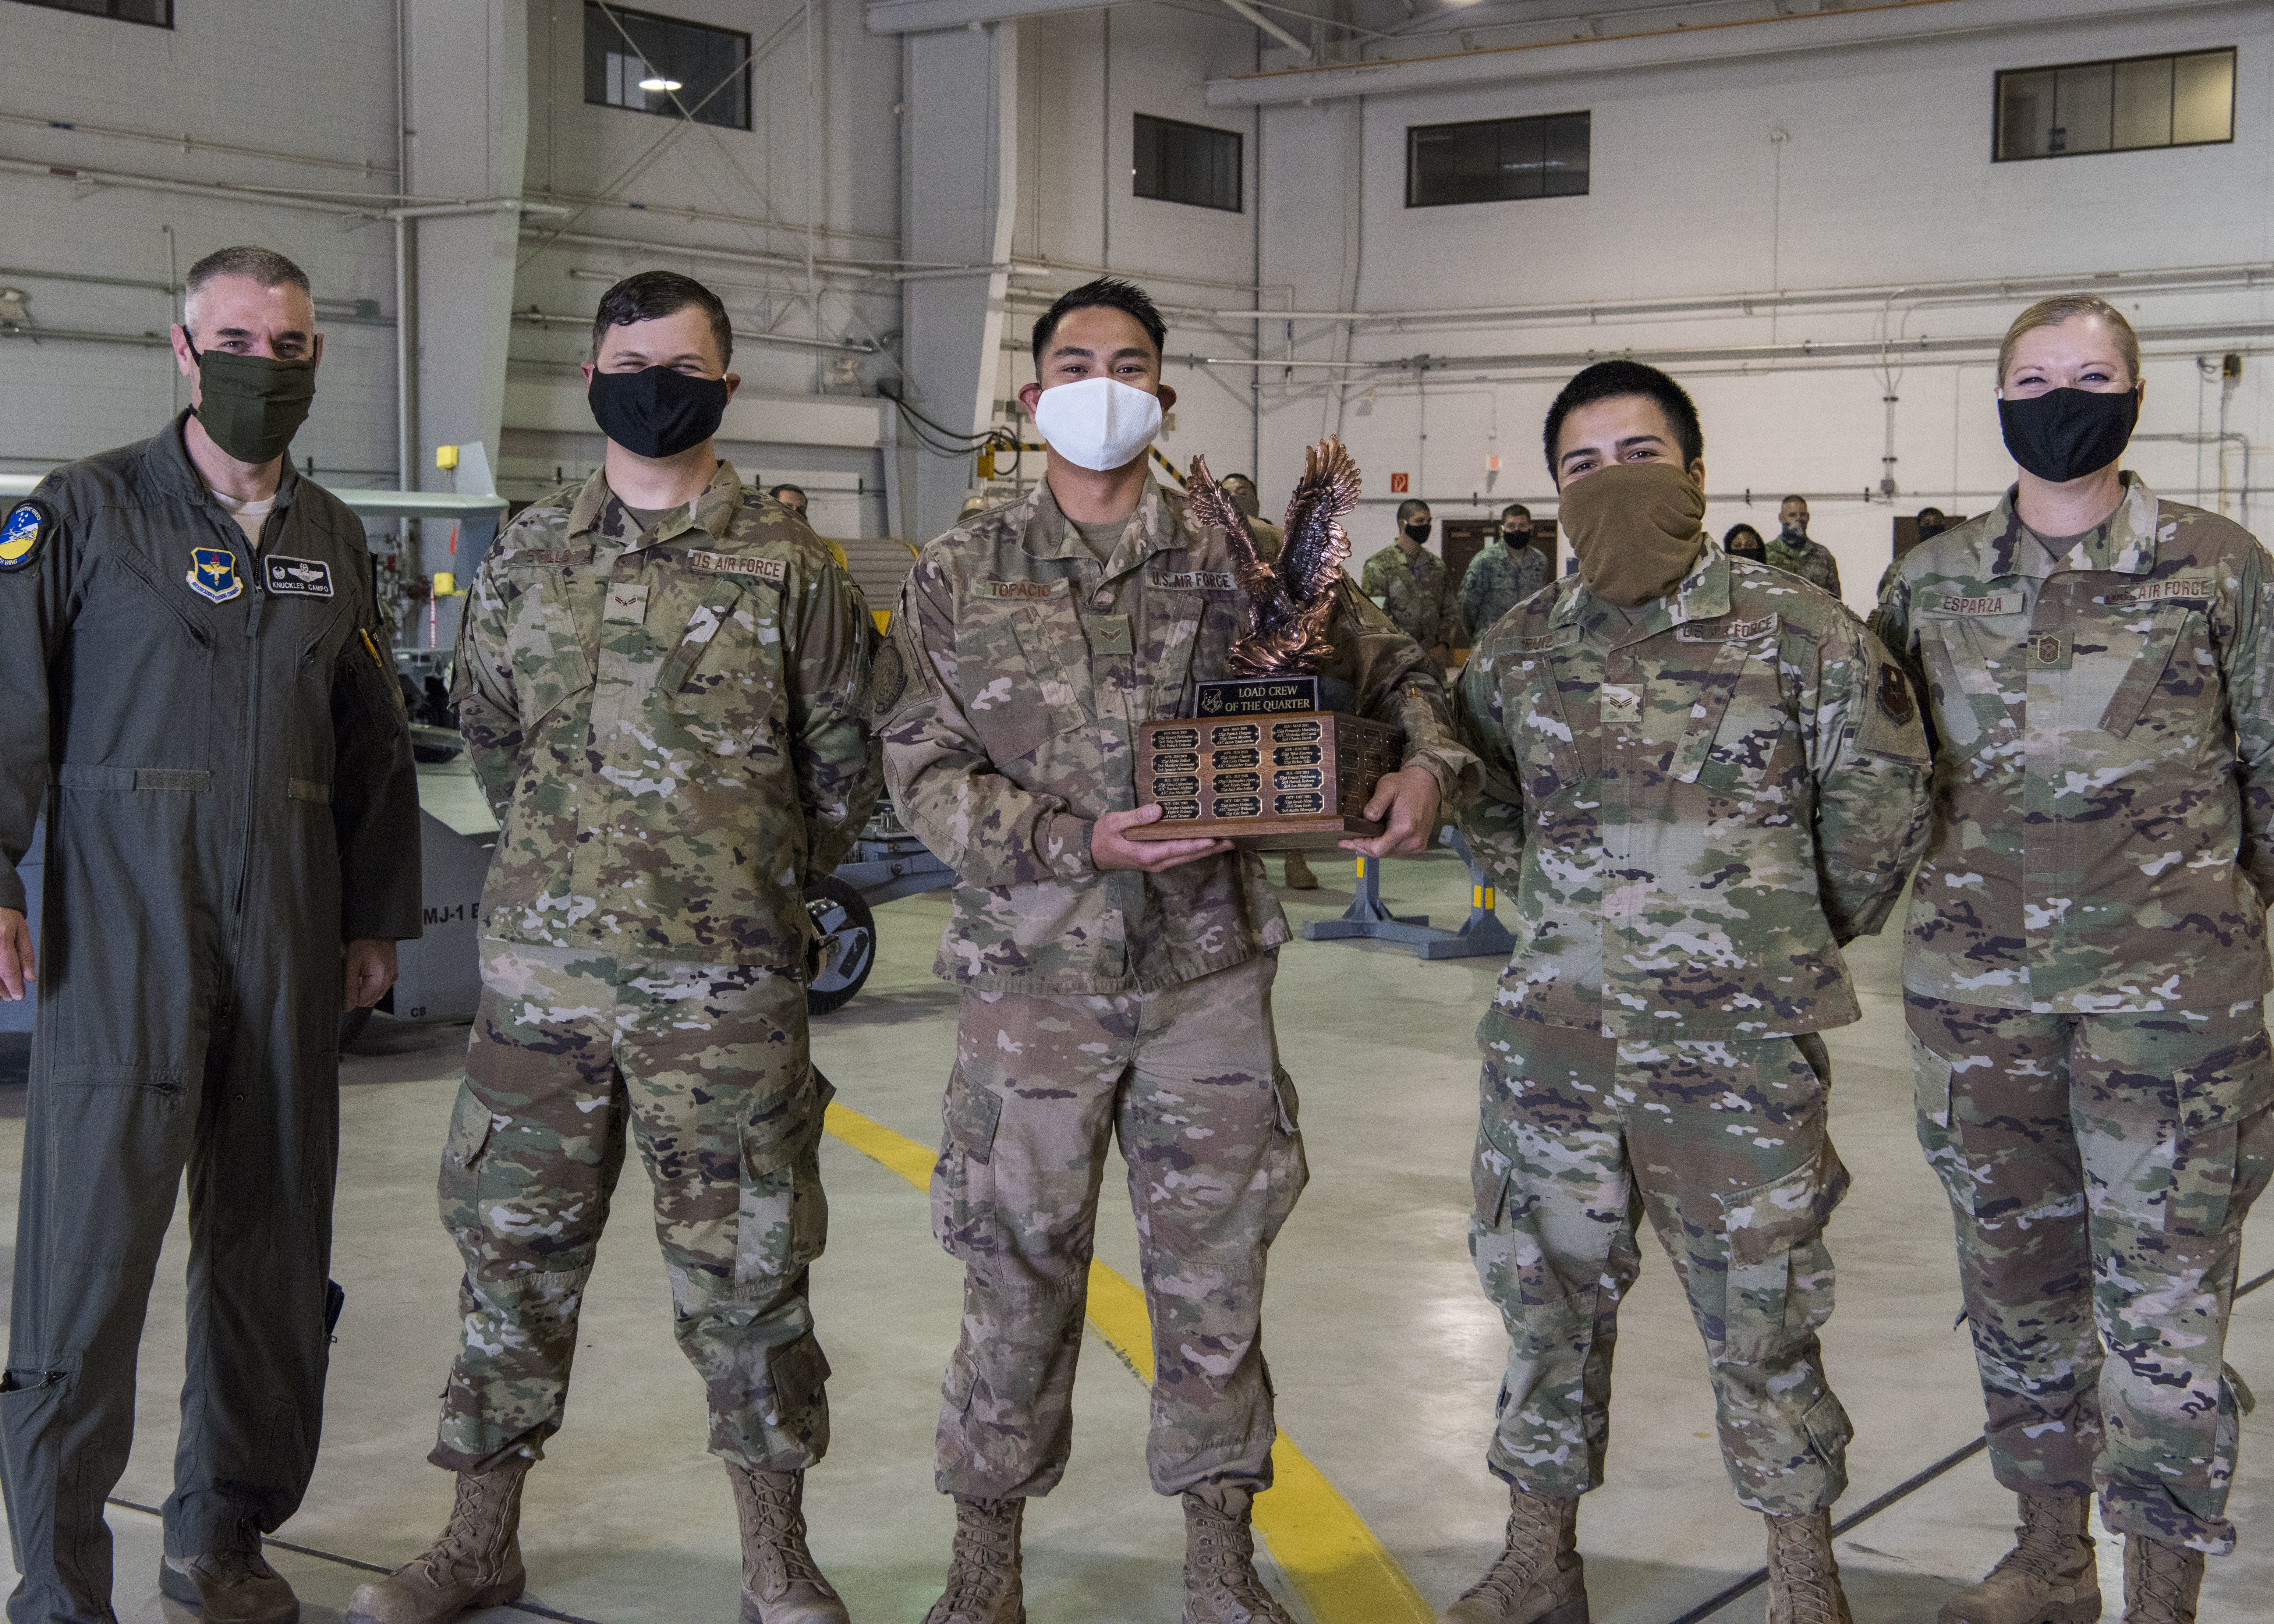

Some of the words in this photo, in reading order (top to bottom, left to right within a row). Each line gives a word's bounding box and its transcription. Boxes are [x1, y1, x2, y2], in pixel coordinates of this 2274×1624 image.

[714, 557, 736, 571] AIR
[738, 558, 781, 578] FORCE
[308, 584, 329, 592] CAMPO
[1152, 571, 1171, 587] U.S.
[1174, 575, 1193, 588] AIR
[1195, 572, 1231, 588] FORCE
[990, 582, 1051, 598] TOPACIO
[2139, 584, 2160, 599] AIR
[2164, 581, 2208, 596] FORCE
[1943, 596, 2002, 614] ESPARZA
[1734, 616, 1772, 638] FORCE
[1523, 635, 1553, 651] RUIZ
[1239, 687, 1266, 697] LOAD
[1268, 685, 1298, 696] CREW
[1225, 702, 1239, 712] OF
[1240, 700, 1261, 711] THE
[1263, 699, 1311, 712] QUARTER
[424, 904, 464, 925] MJ-1
